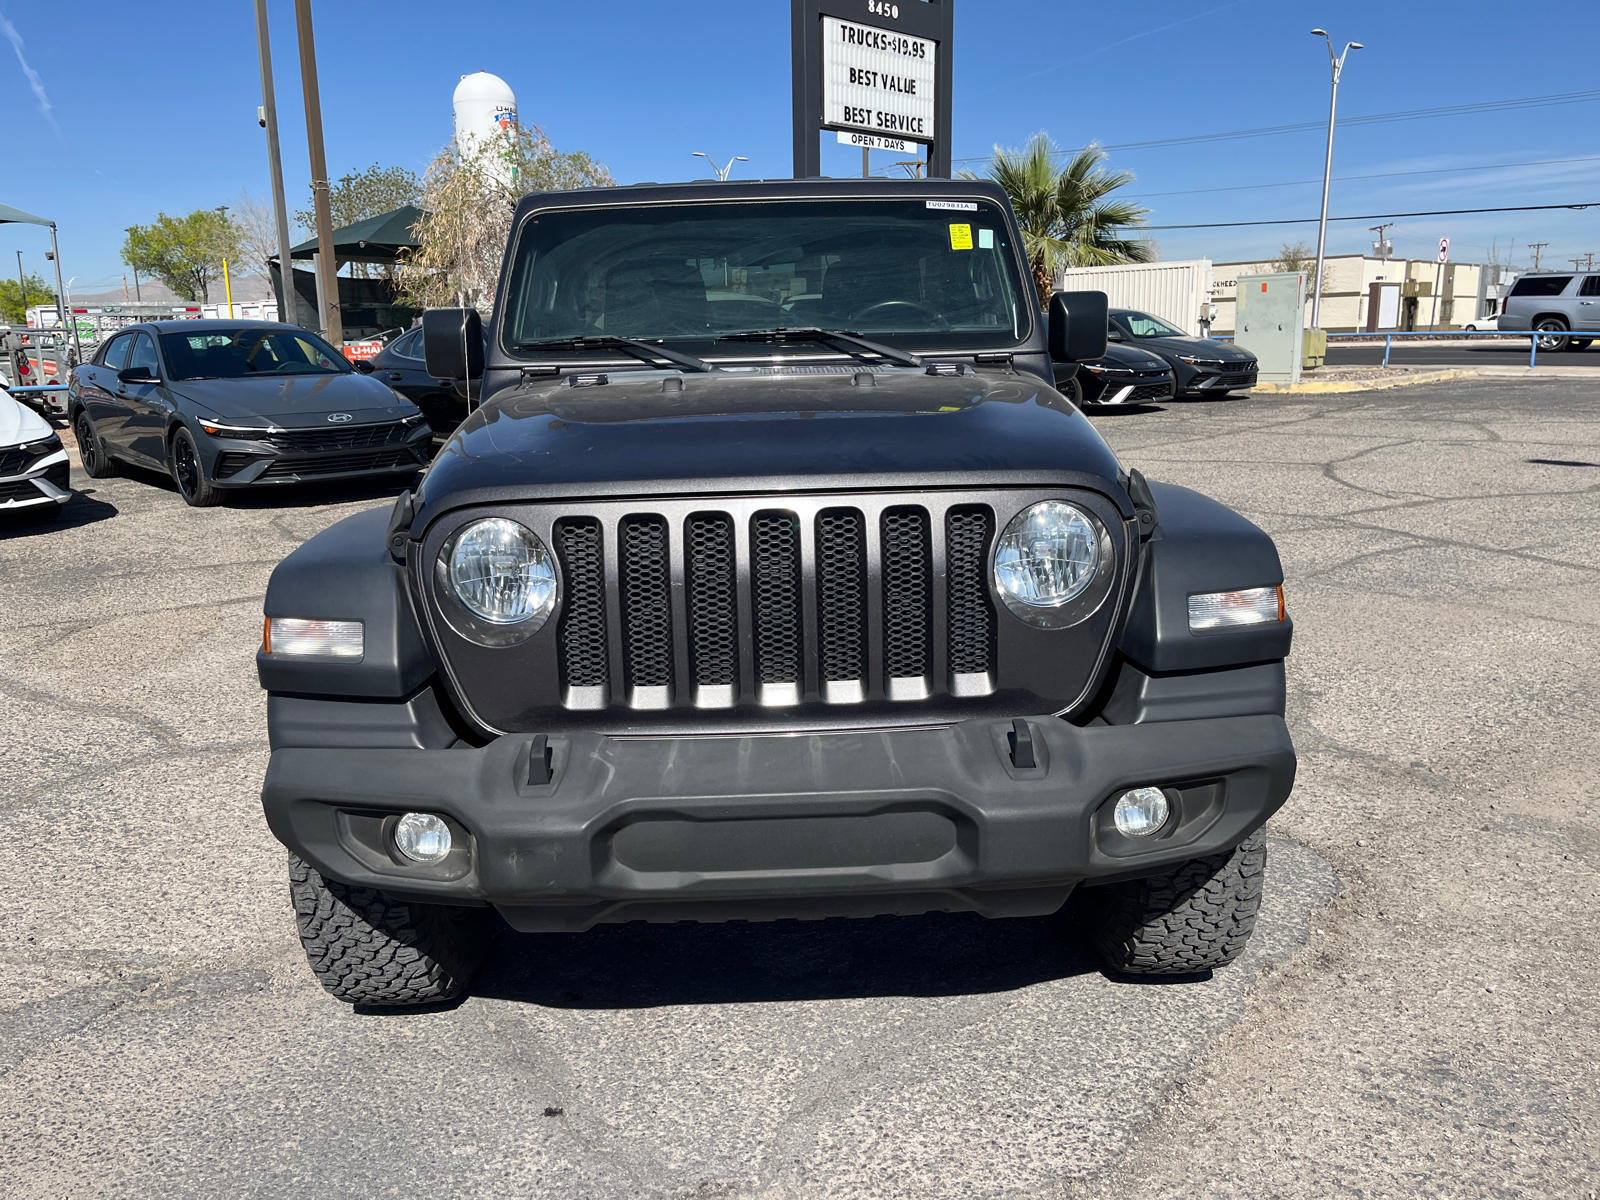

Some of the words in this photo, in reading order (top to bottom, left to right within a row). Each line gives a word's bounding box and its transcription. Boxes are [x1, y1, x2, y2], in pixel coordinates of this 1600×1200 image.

[868, 0, 899, 19] 8450
[849, 67, 878, 88] BEST
[881, 73, 916, 95] VALUE
[844, 105, 872, 126] BEST
[877, 111, 923, 133] SERVICE
[851, 134, 874, 147] OPEN
[877, 138, 882, 147] 7
[884, 139, 905, 151] DAYS
